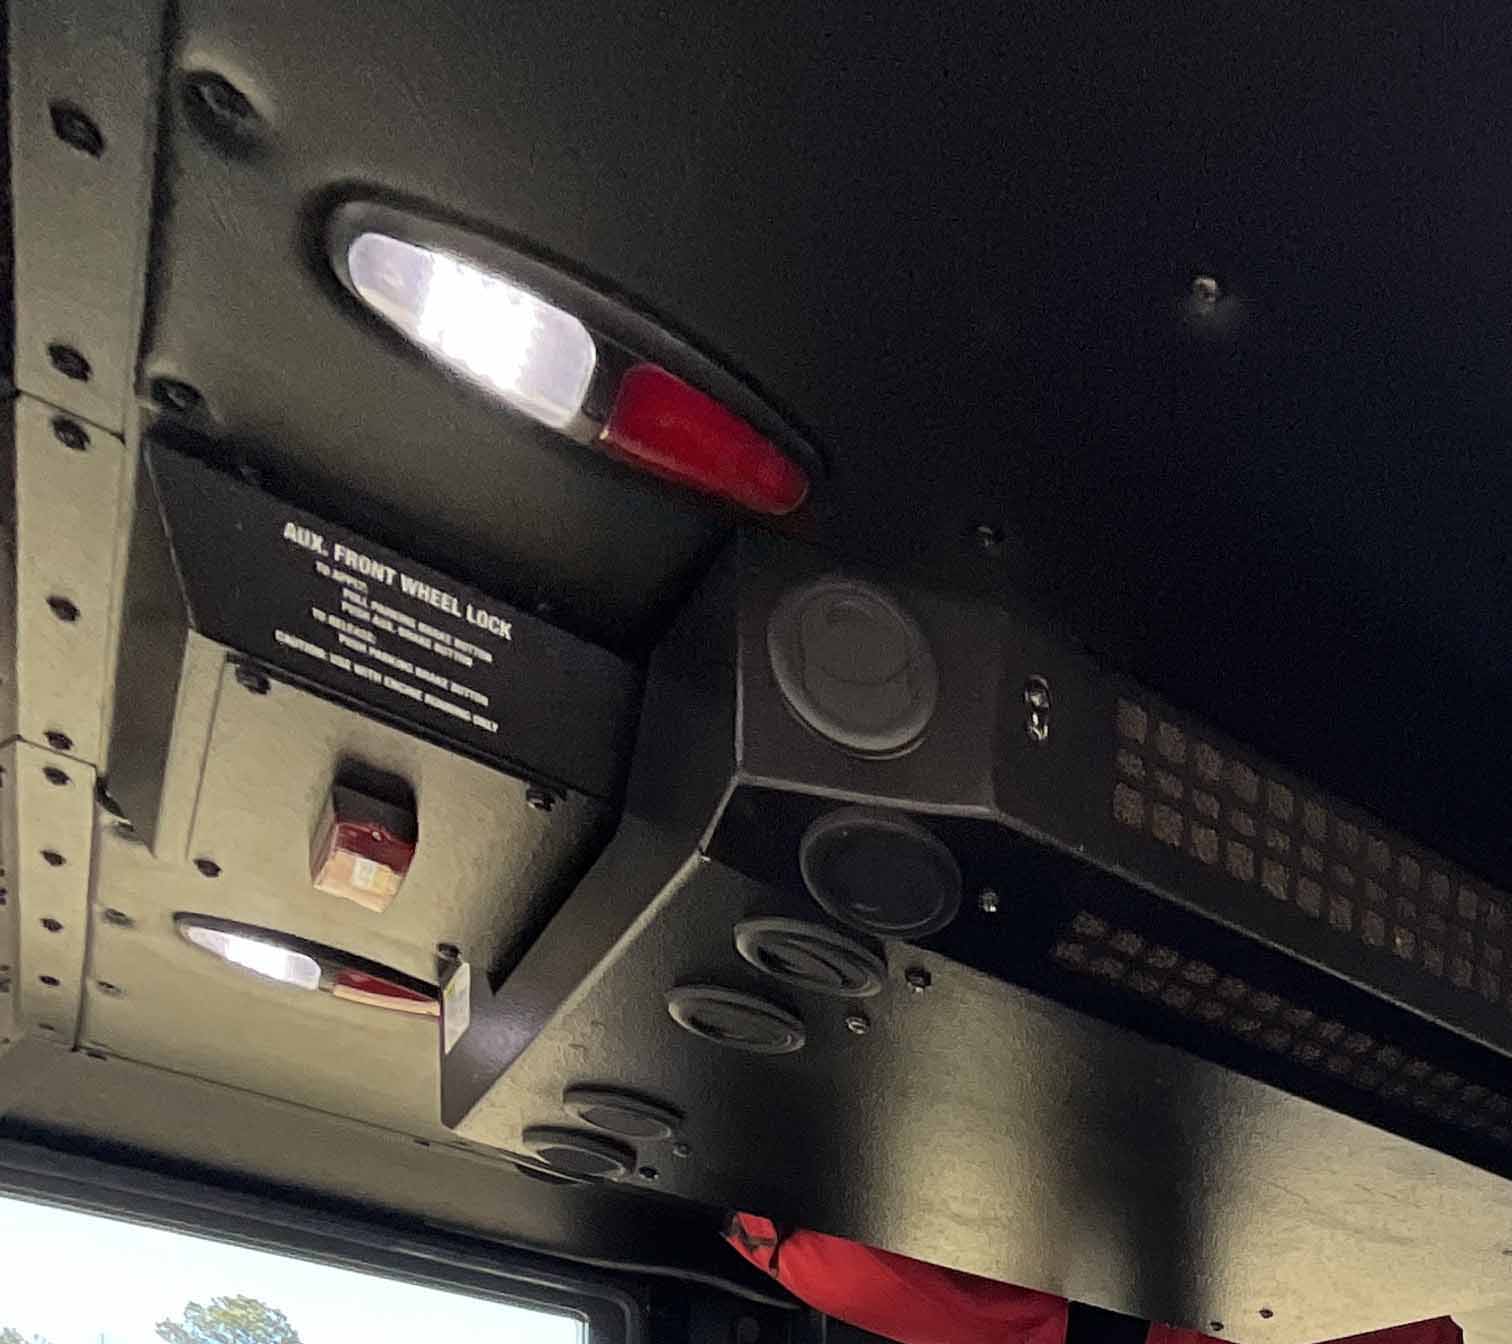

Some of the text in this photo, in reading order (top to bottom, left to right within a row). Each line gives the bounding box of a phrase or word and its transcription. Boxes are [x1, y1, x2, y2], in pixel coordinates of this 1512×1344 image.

[284, 523, 512, 640] AUX. FRONT WHEEL LOCK
